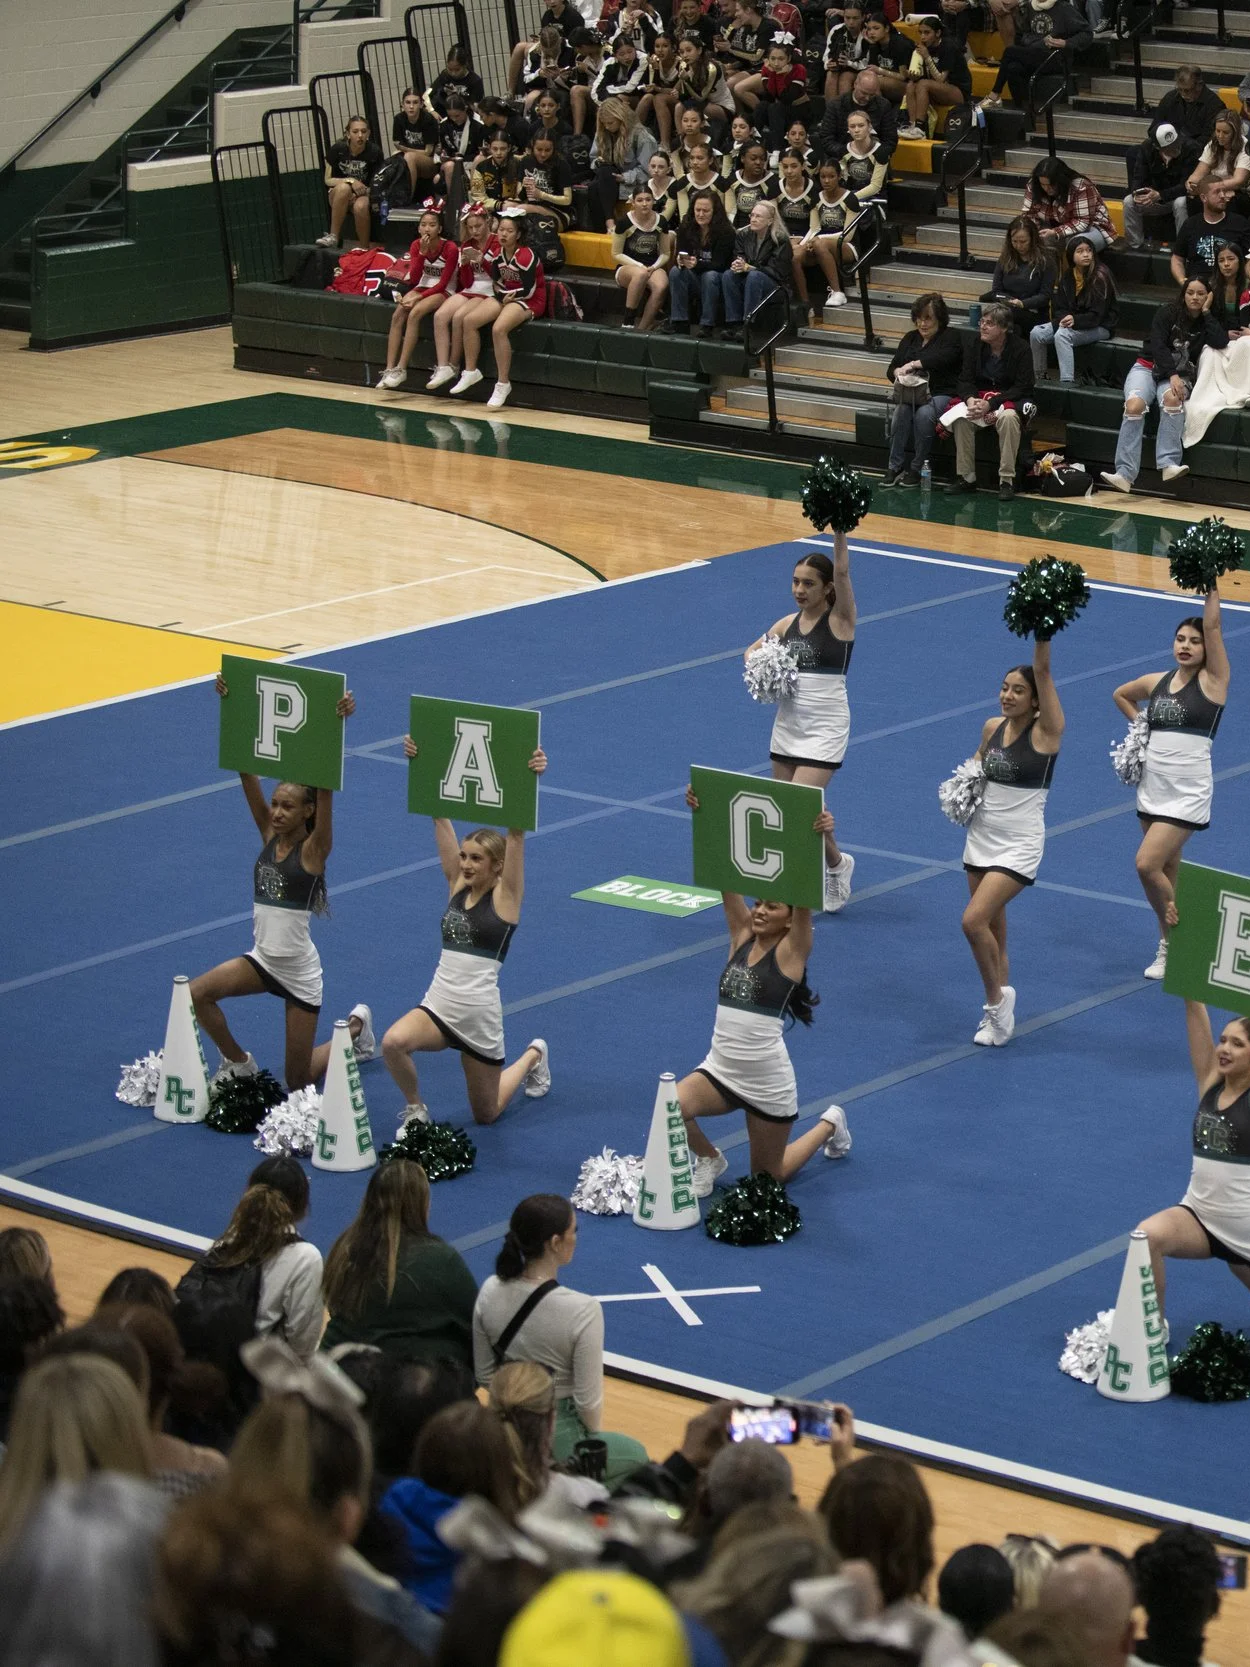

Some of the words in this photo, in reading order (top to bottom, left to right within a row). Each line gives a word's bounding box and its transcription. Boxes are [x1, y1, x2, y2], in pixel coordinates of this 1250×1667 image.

[254, 675, 308, 762] P
[439, 717, 503, 808] A
[729, 790, 784, 882] C
[592, 880, 720, 908] BLOCK
[165, 1075, 195, 1116] PC
[664, 1100, 697, 1214] PACERS
[1104, 1342, 1133, 1393] PC
[1139, 1264, 1171, 1388] PACERS
